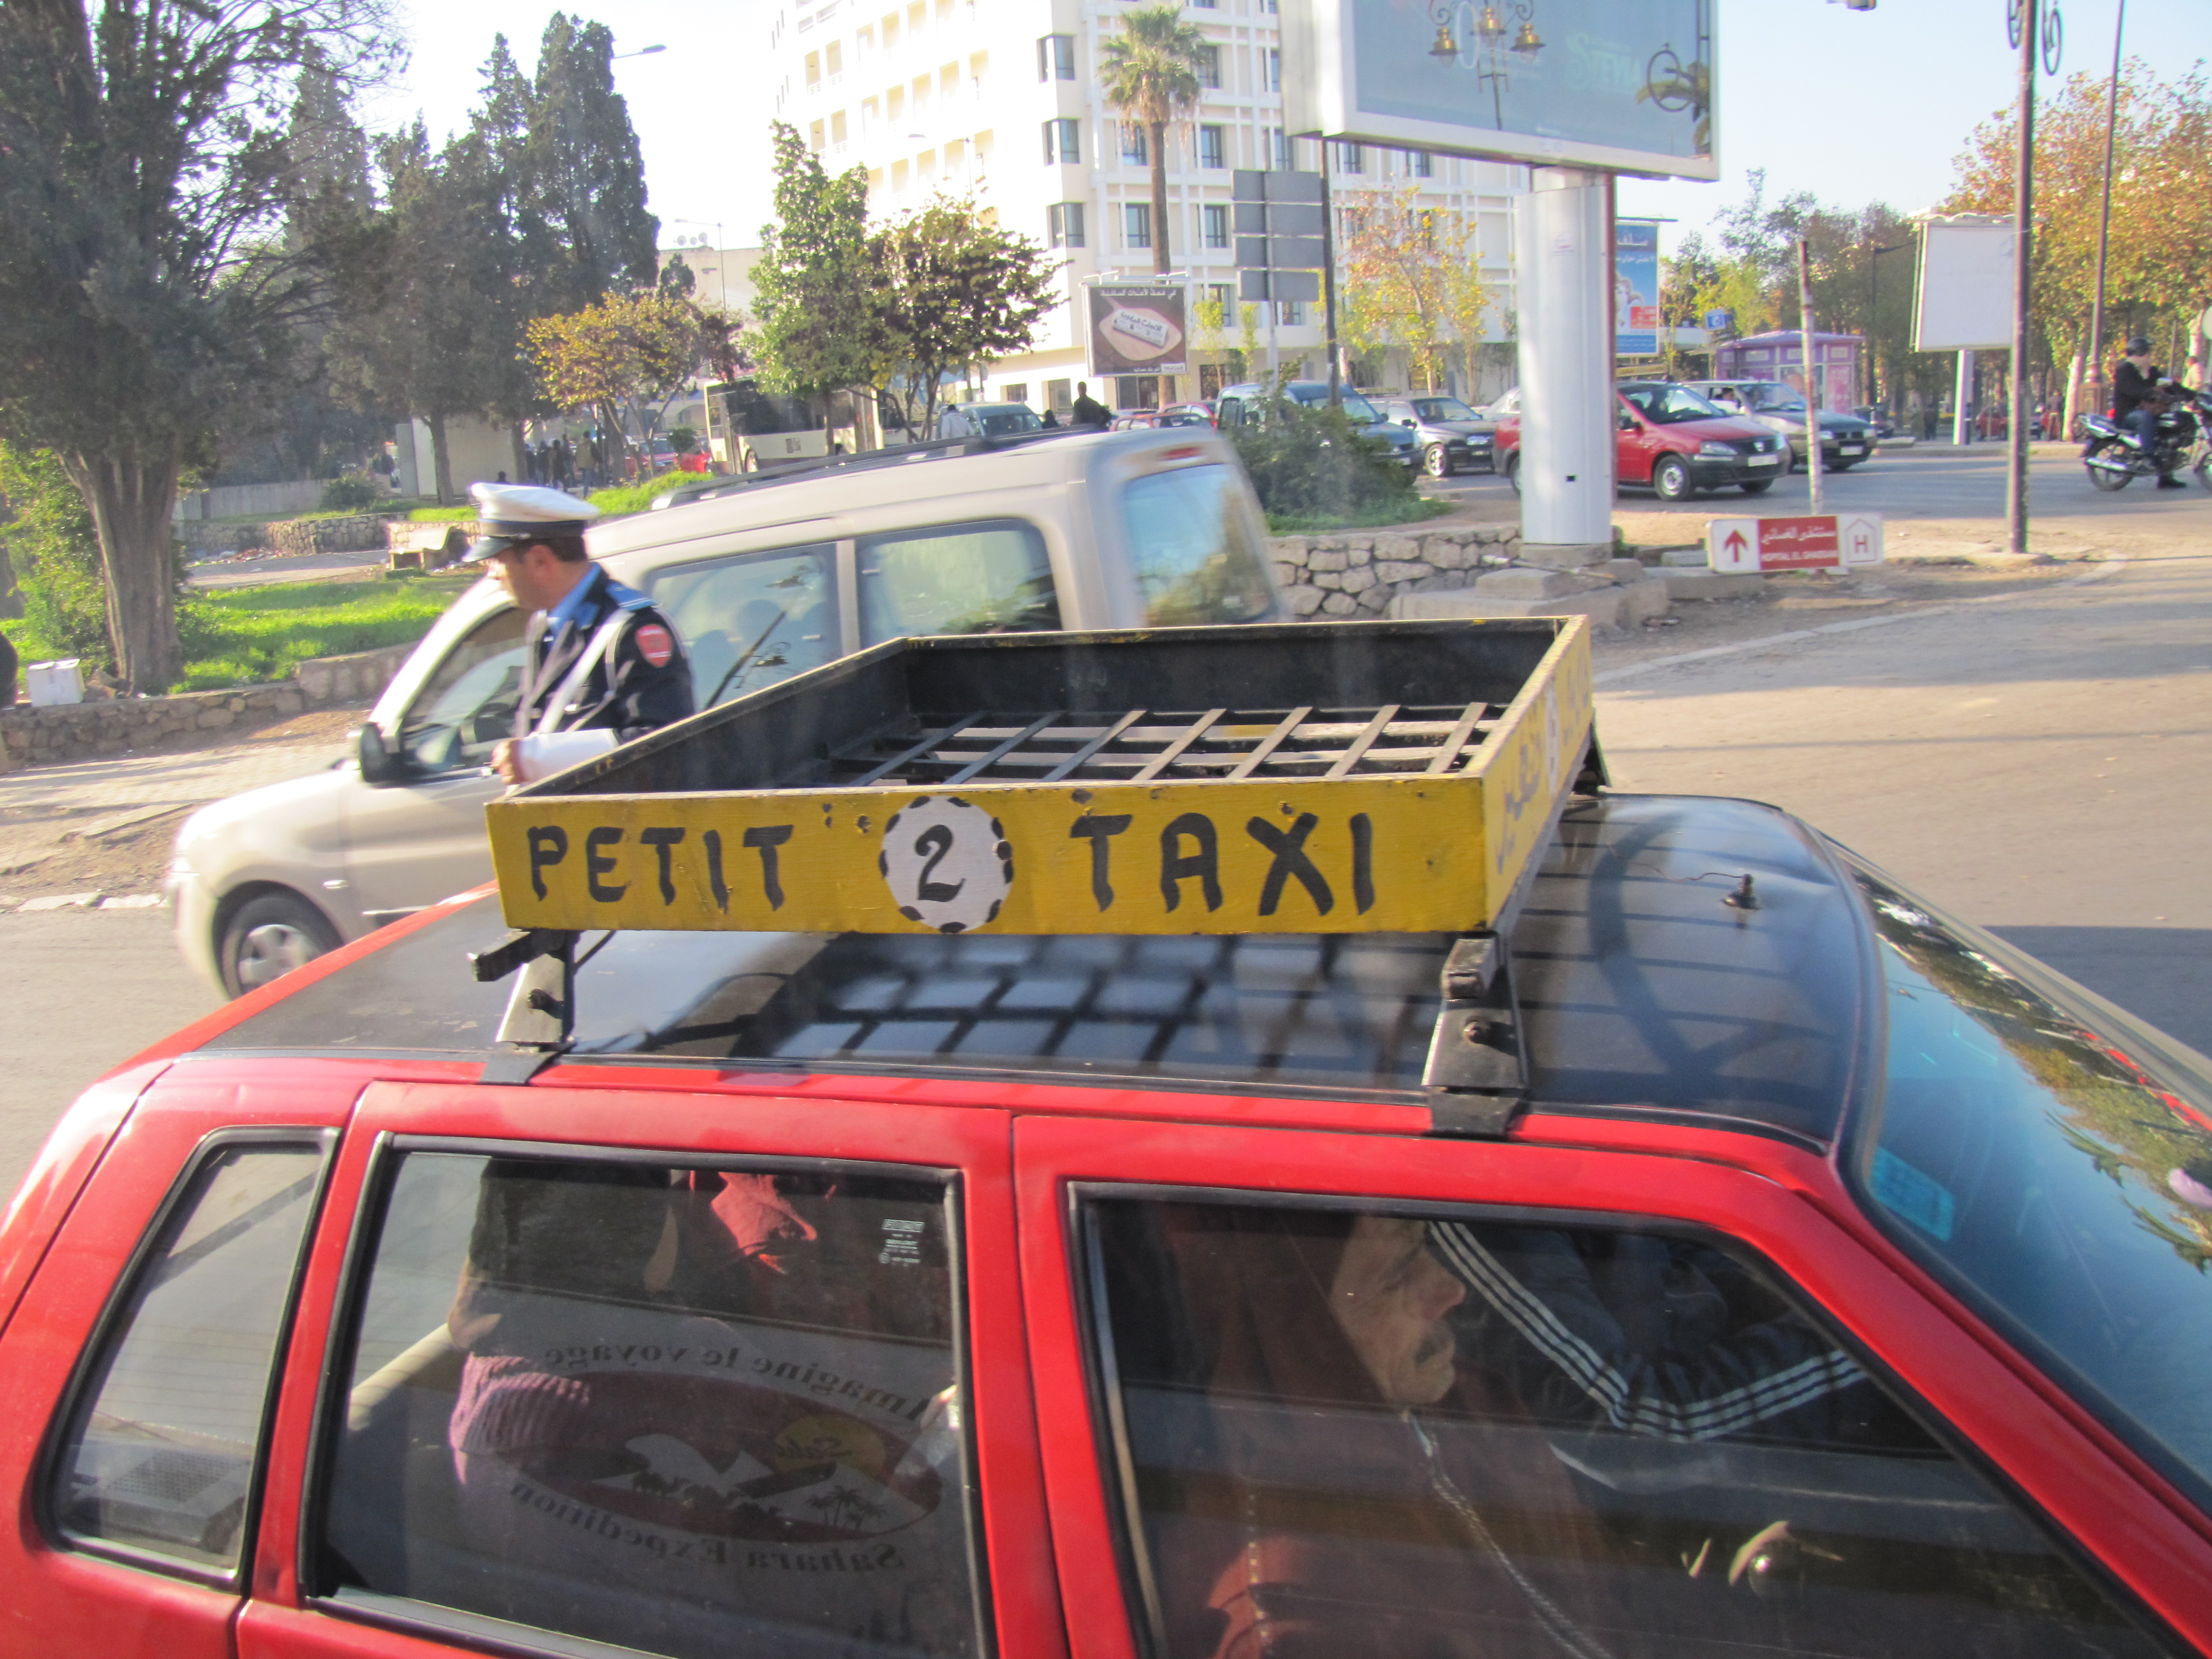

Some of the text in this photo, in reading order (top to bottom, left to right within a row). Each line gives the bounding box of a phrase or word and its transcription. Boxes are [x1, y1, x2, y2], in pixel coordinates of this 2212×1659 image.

[527, 812, 1375, 916] PETIT 2 TAXI
